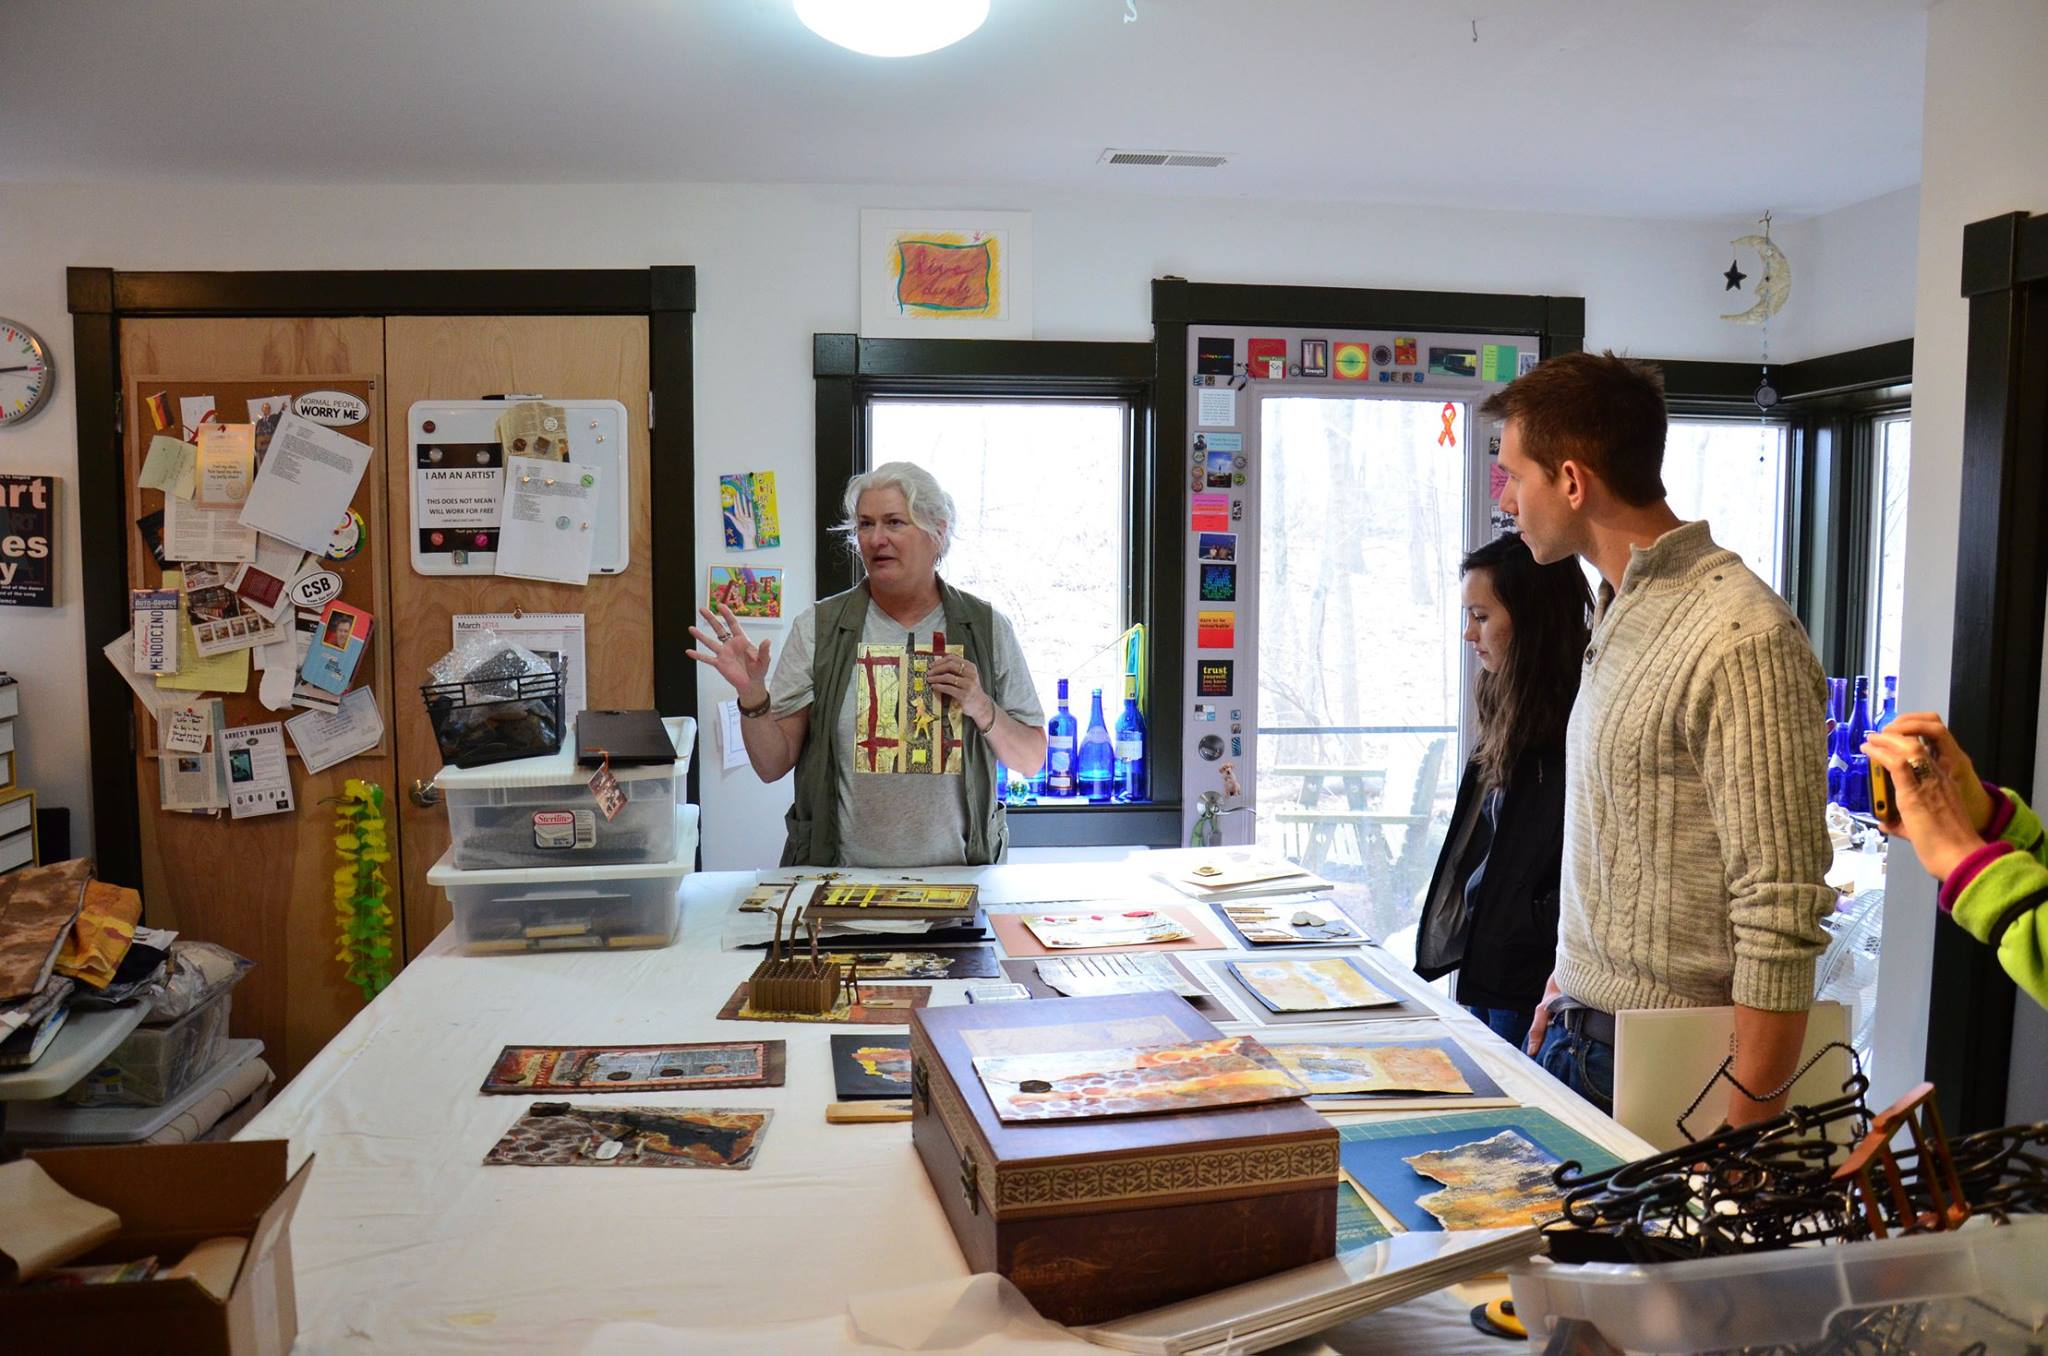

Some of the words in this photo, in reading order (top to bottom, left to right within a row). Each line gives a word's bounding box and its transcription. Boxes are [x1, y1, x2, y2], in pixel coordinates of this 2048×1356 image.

[301, 398, 331, 407] NORMAL
[333, 400, 360, 409] PEOPLE
[301, 405, 341, 418] WORRY
[343, 409, 359, 420] ME
[431, 471, 447, 480] AM
[449, 471, 463, 479] AN
[465, 470, 496, 479] ARTIST
[301, 577, 332, 598] CSB
[722, 575, 776, 611] ART
[457, 621, 481, 629] March
[481, 622, 500, 630] 2014
[150, 609, 164, 670] MENDOCINO
[1203, 666, 1227, 674] trust
[224, 731, 248, 740] ARREST
[249, 726, 279, 737] WARRANT
[538, 814, 568, 823] Sterilite
